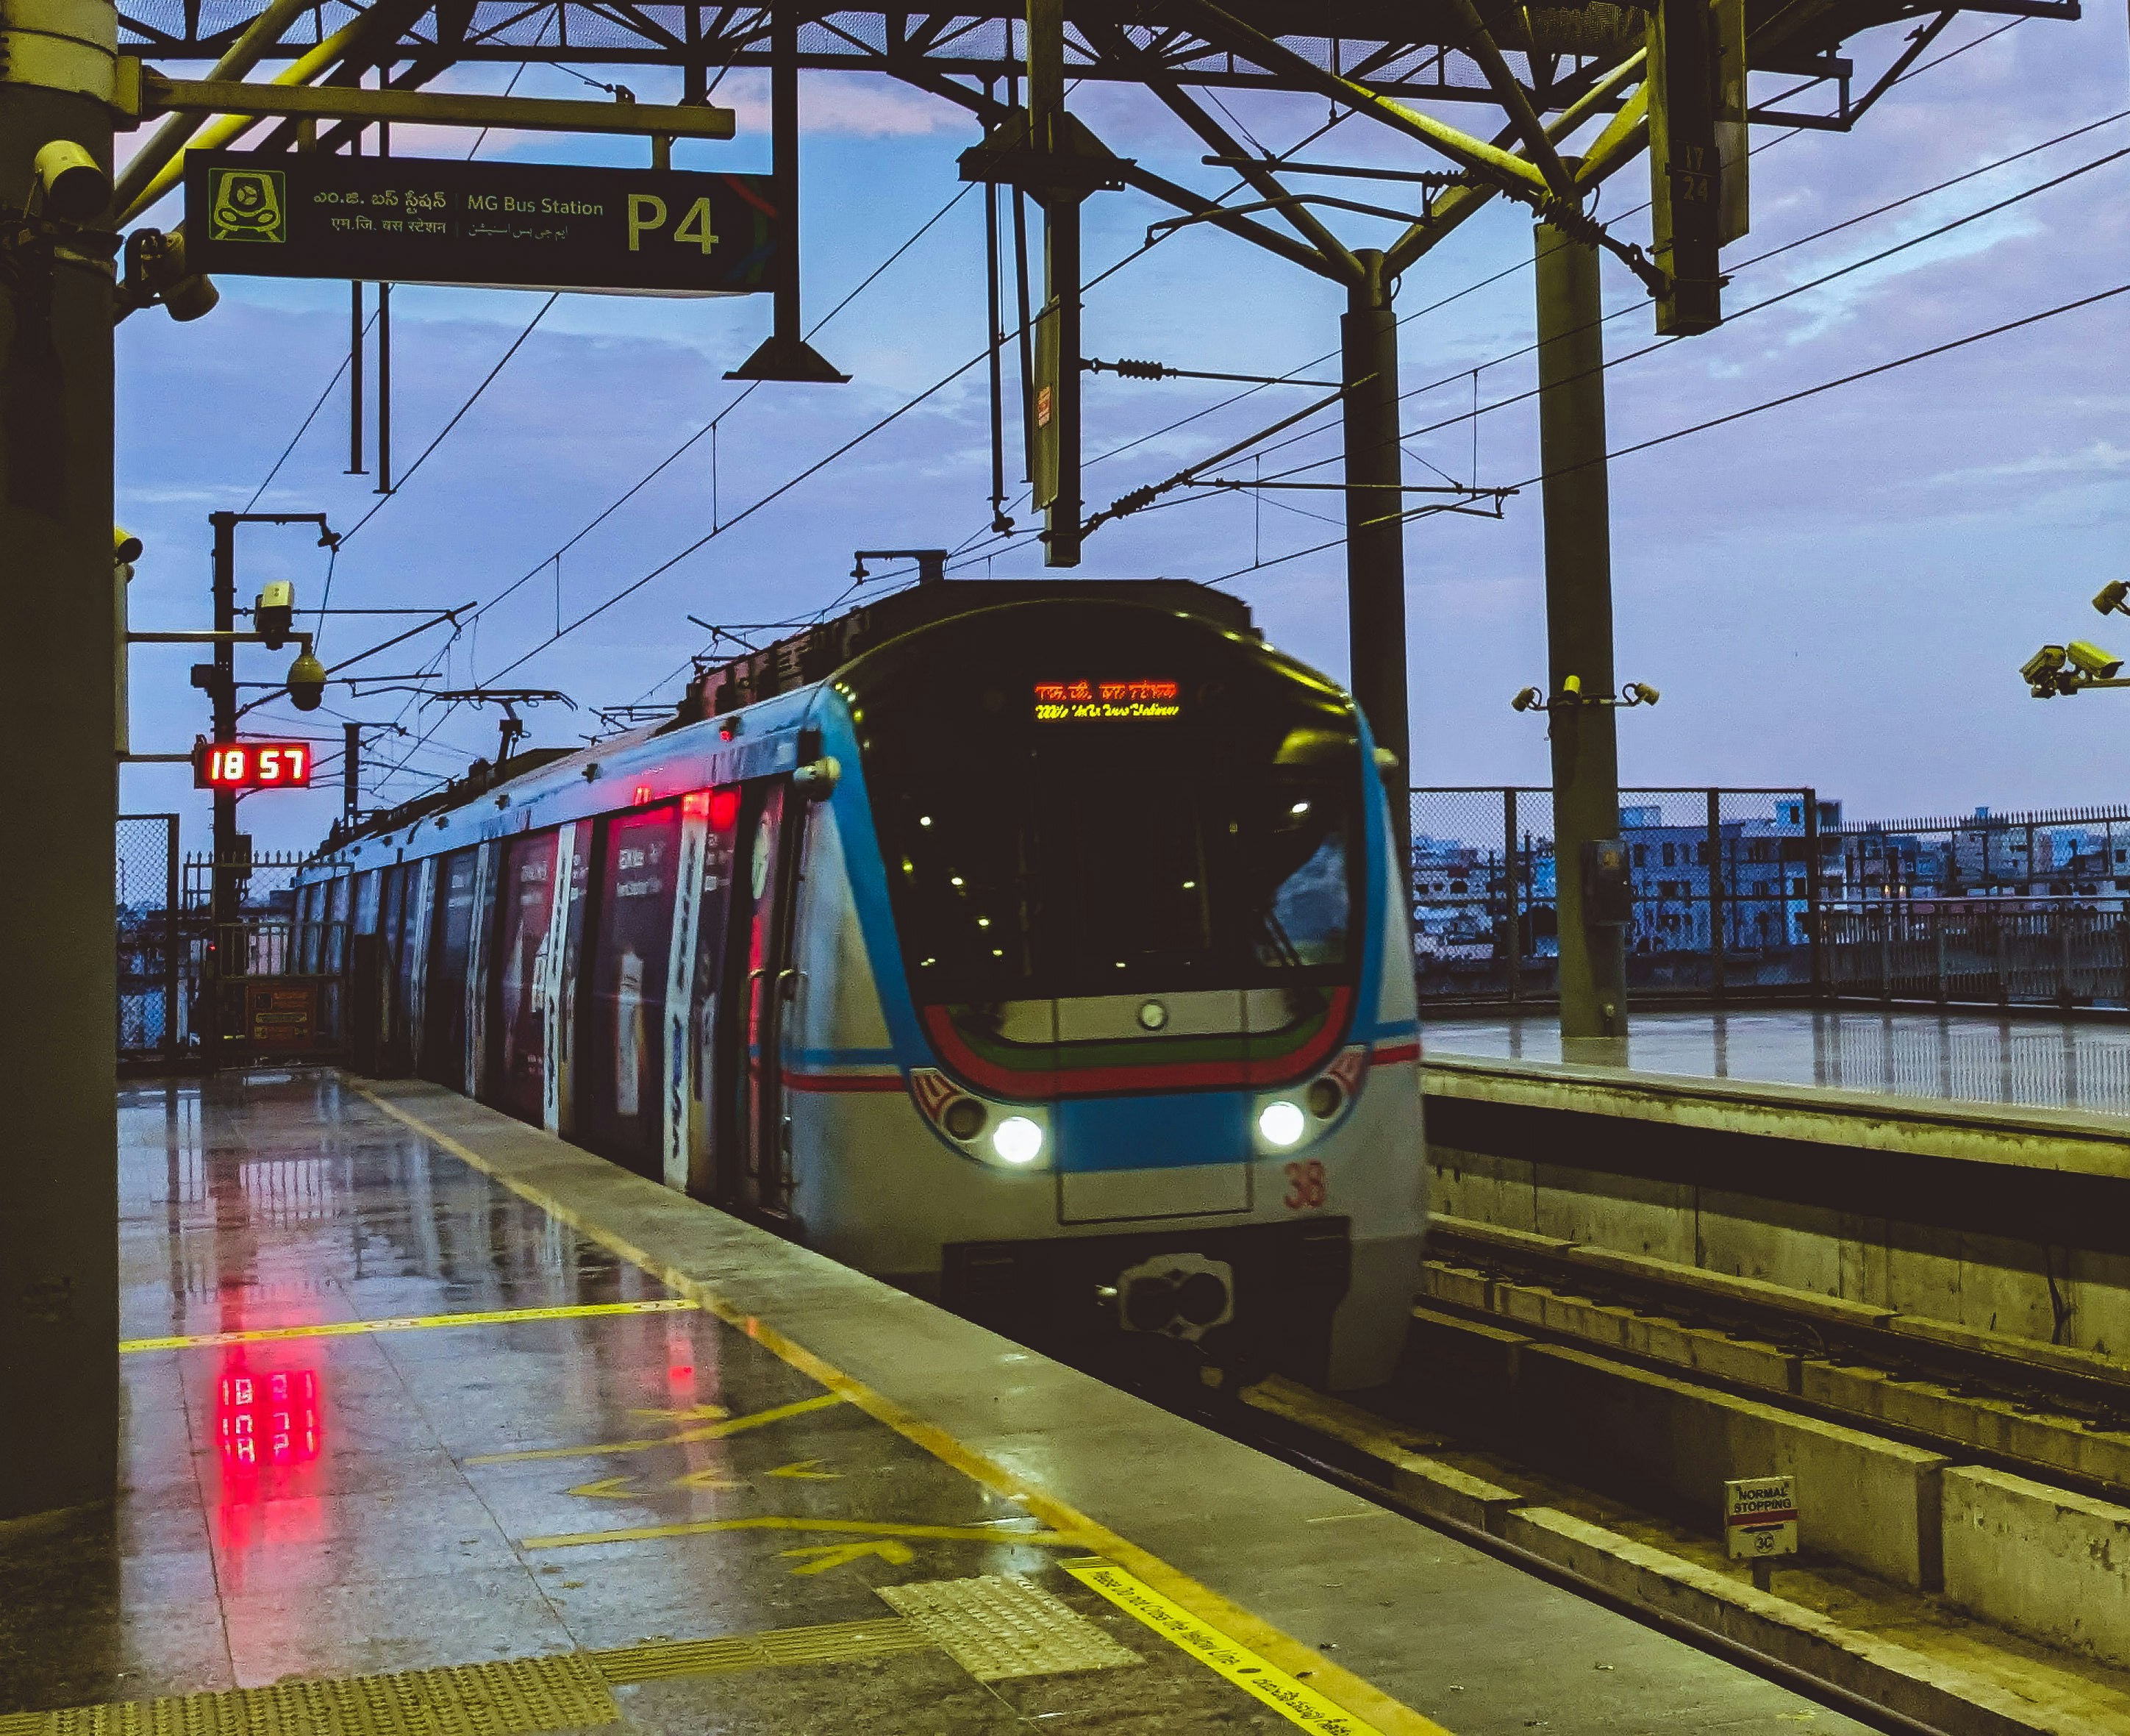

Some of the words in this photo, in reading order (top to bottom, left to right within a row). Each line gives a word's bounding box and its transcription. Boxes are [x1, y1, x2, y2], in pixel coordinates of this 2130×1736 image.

[468, 195, 498, 211] MG
[504, 196, 536, 212] Bus
[541, 198, 604, 215] Station
[628, 193, 719, 254] P4
[211, 748, 245, 780] 18
[260, 747, 304, 780] 57
[1282, 1160, 1326, 1209] 38
[1733, 1499, 1792, 1514] STOPPING
[1737, 1487, 1789, 1501] NORMAL
